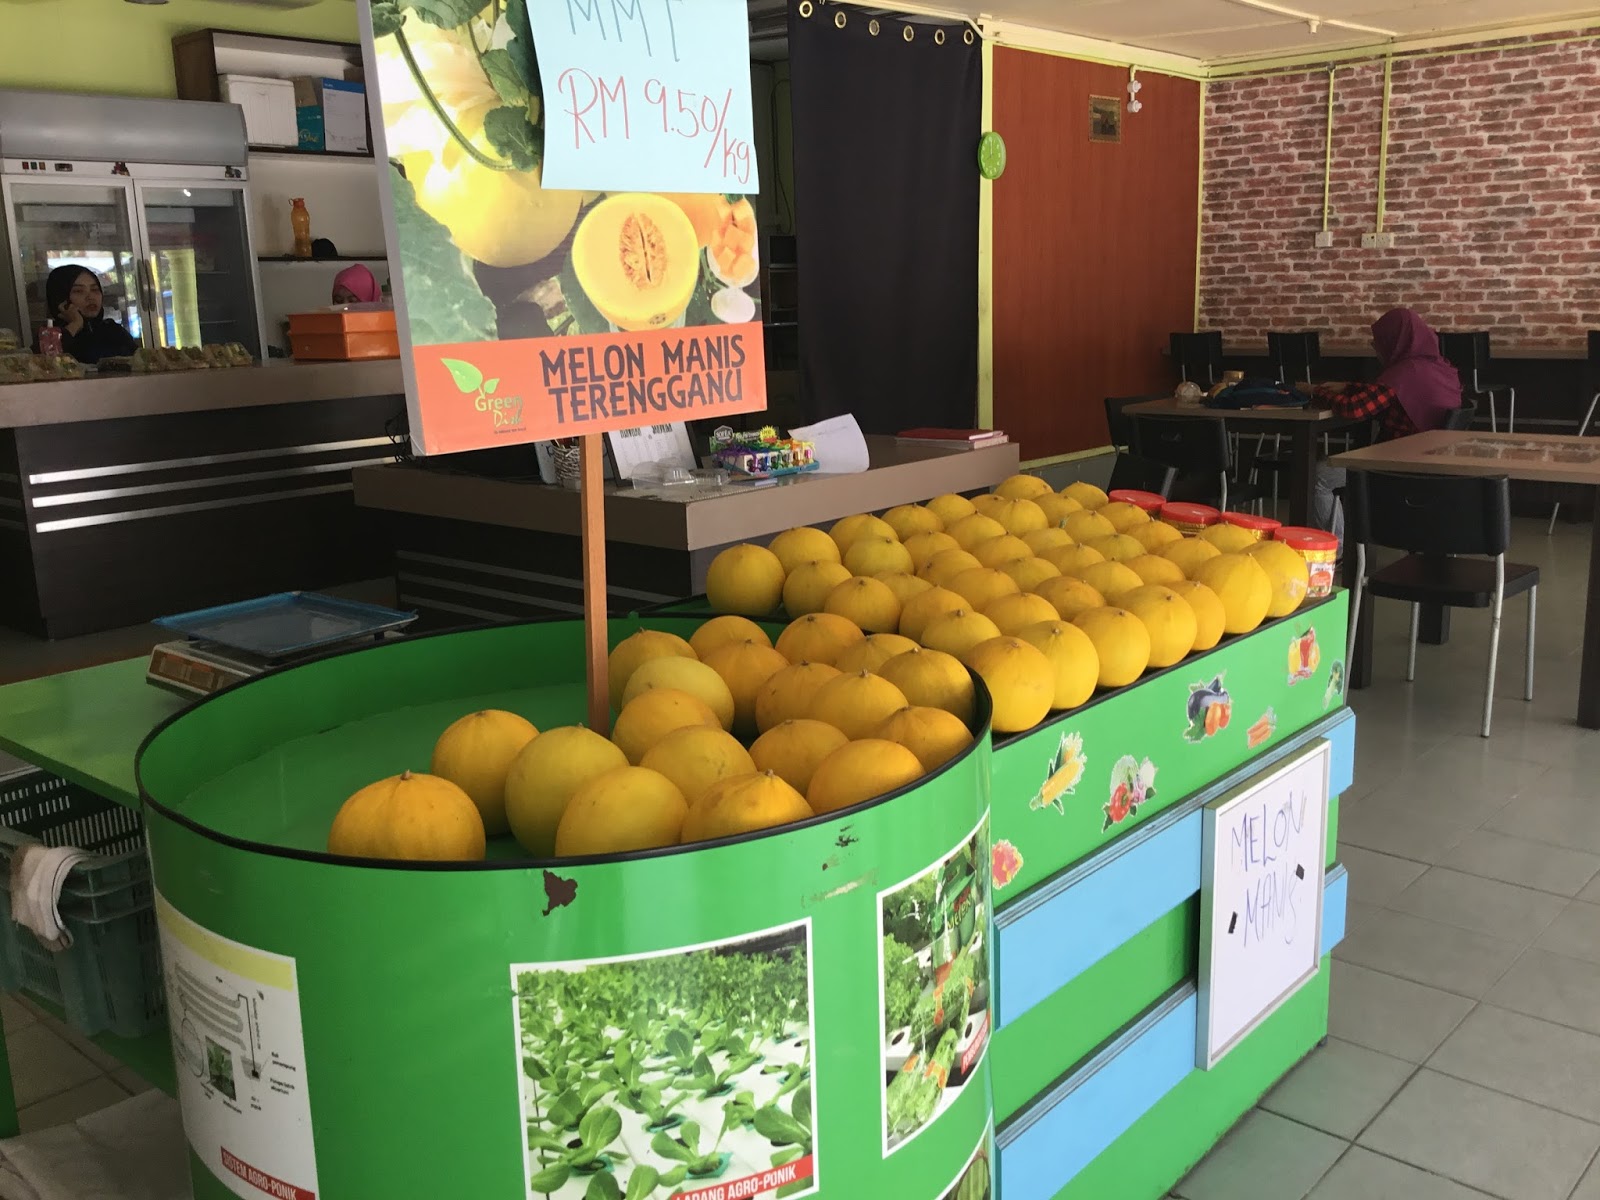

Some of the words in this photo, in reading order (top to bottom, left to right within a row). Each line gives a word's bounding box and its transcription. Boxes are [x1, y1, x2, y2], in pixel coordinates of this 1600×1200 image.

[557, 67, 630, 150] RM
[539, 342, 646, 388] MELON
[660, 334, 746, 376] MANIS
[474, 395, 523, 413] Green
[547, 368, 744, 425] TERENGGANU
[1231, 789, 1307, 873] MELON
[222, 1150, 248, 1180] SISTEM
[248, 1168, 297, 1200] AGRO-PONIK
[727, 1163, 797, 1200] AGRO-PONIK
